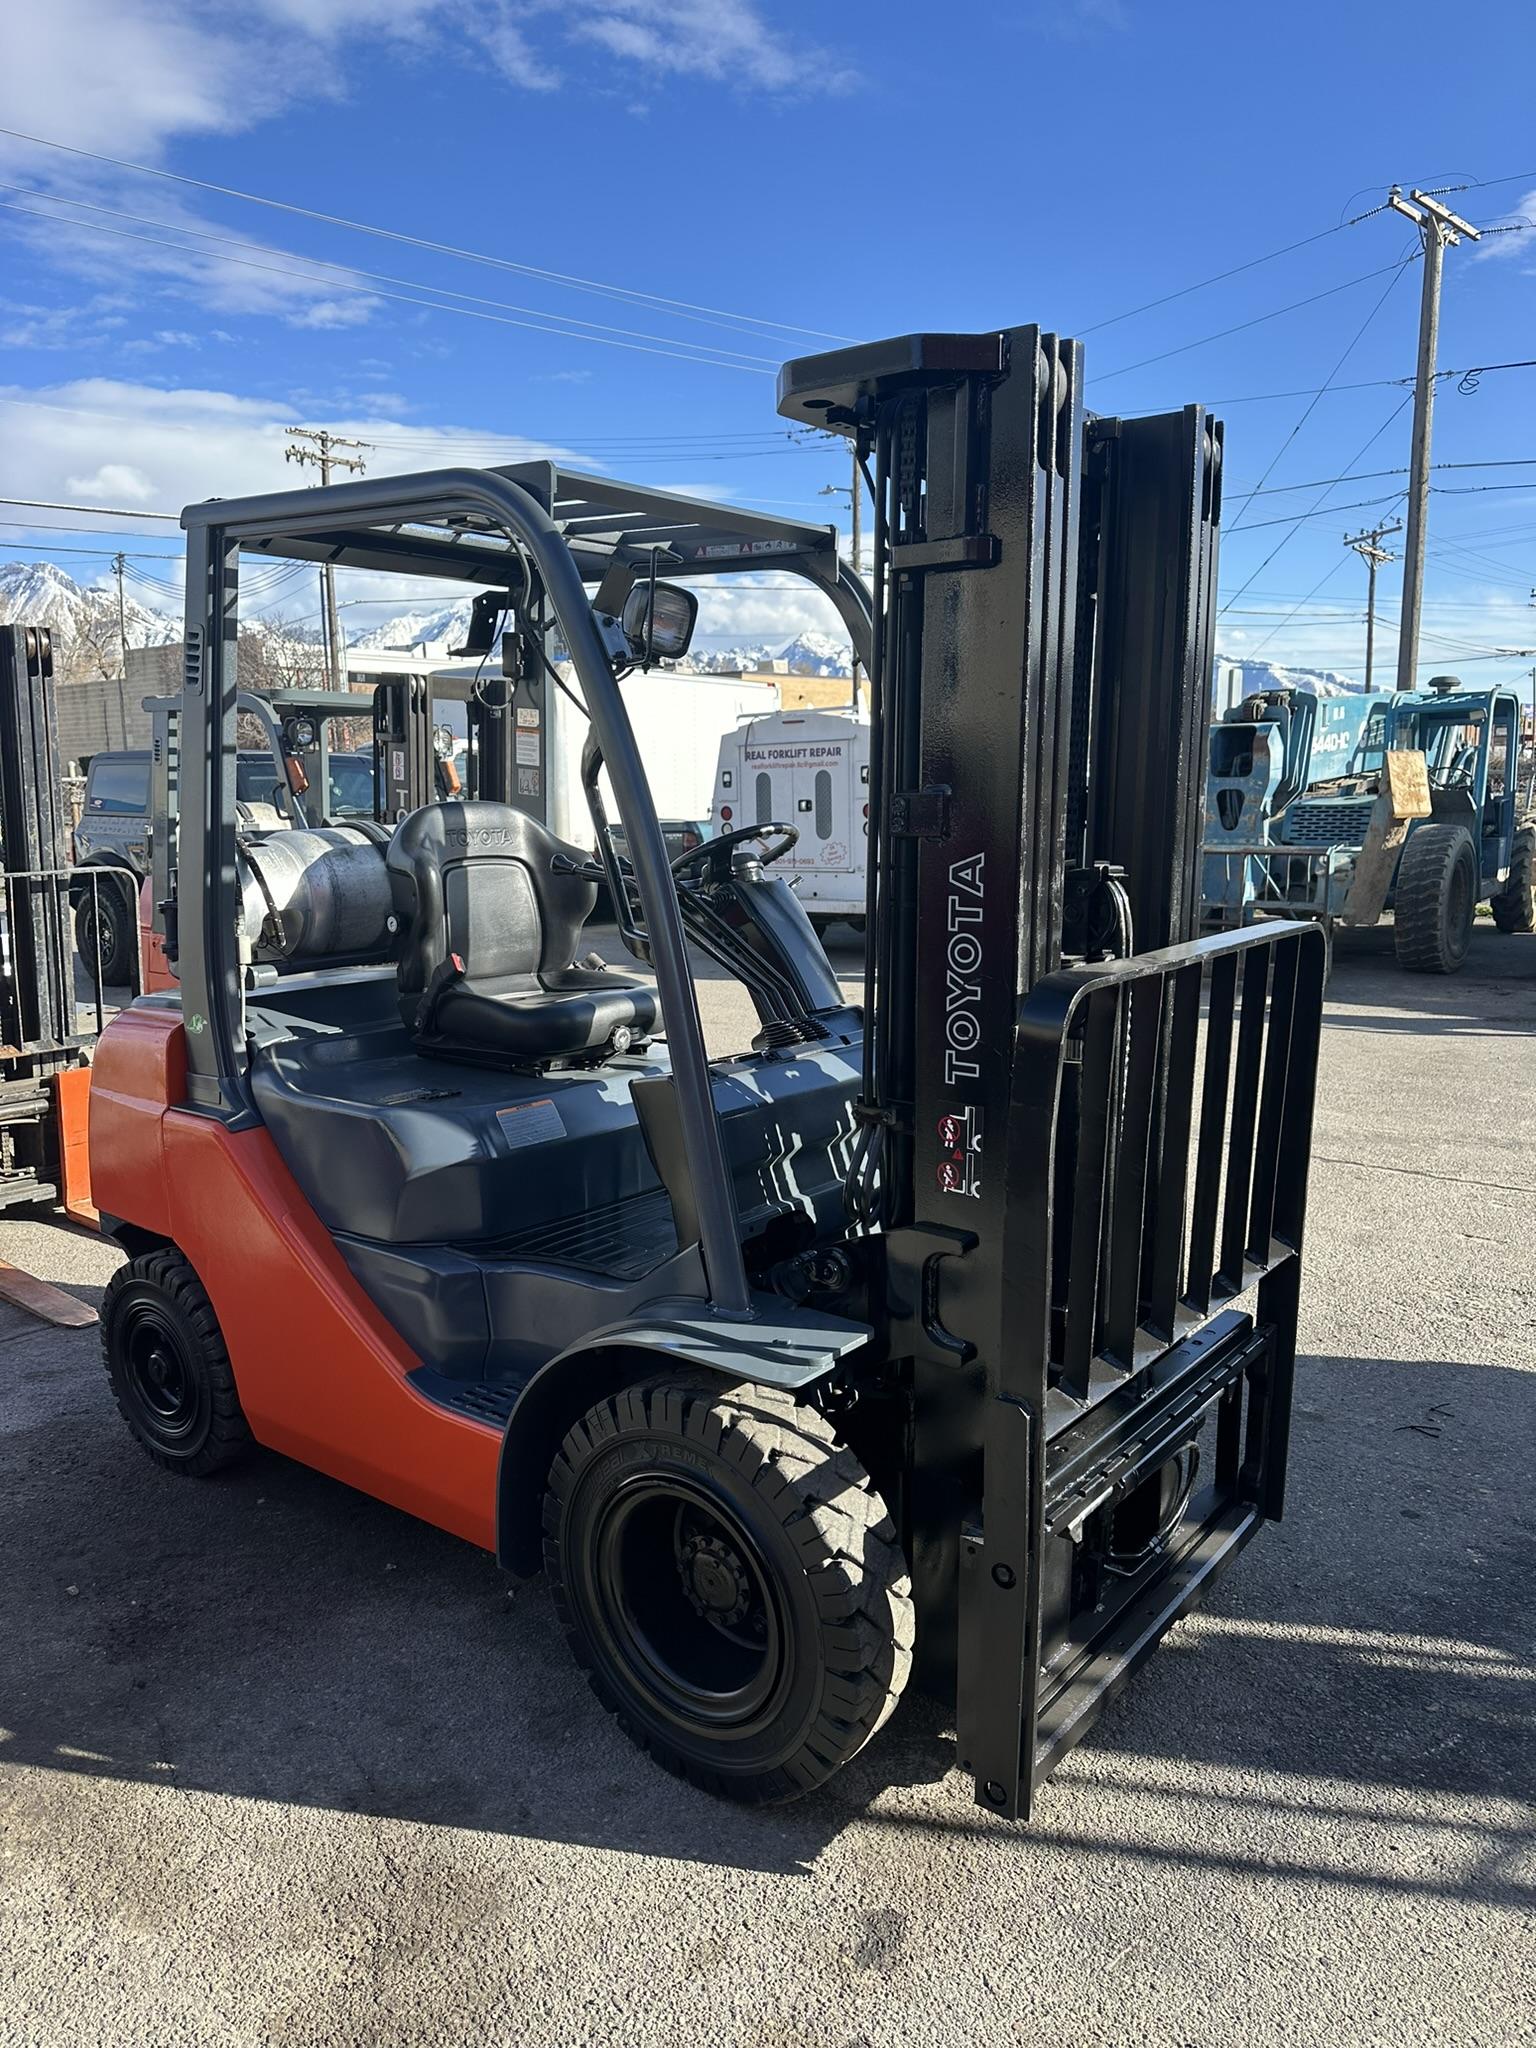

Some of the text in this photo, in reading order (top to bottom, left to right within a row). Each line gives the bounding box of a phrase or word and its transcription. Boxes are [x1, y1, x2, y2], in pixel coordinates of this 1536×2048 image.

[746, 747, 842, 761] REAL FORKLIFT REPAIR
[446, 828, 514, 848] TOYOTA
[945, 852, 985, 1084] TOYOTA
